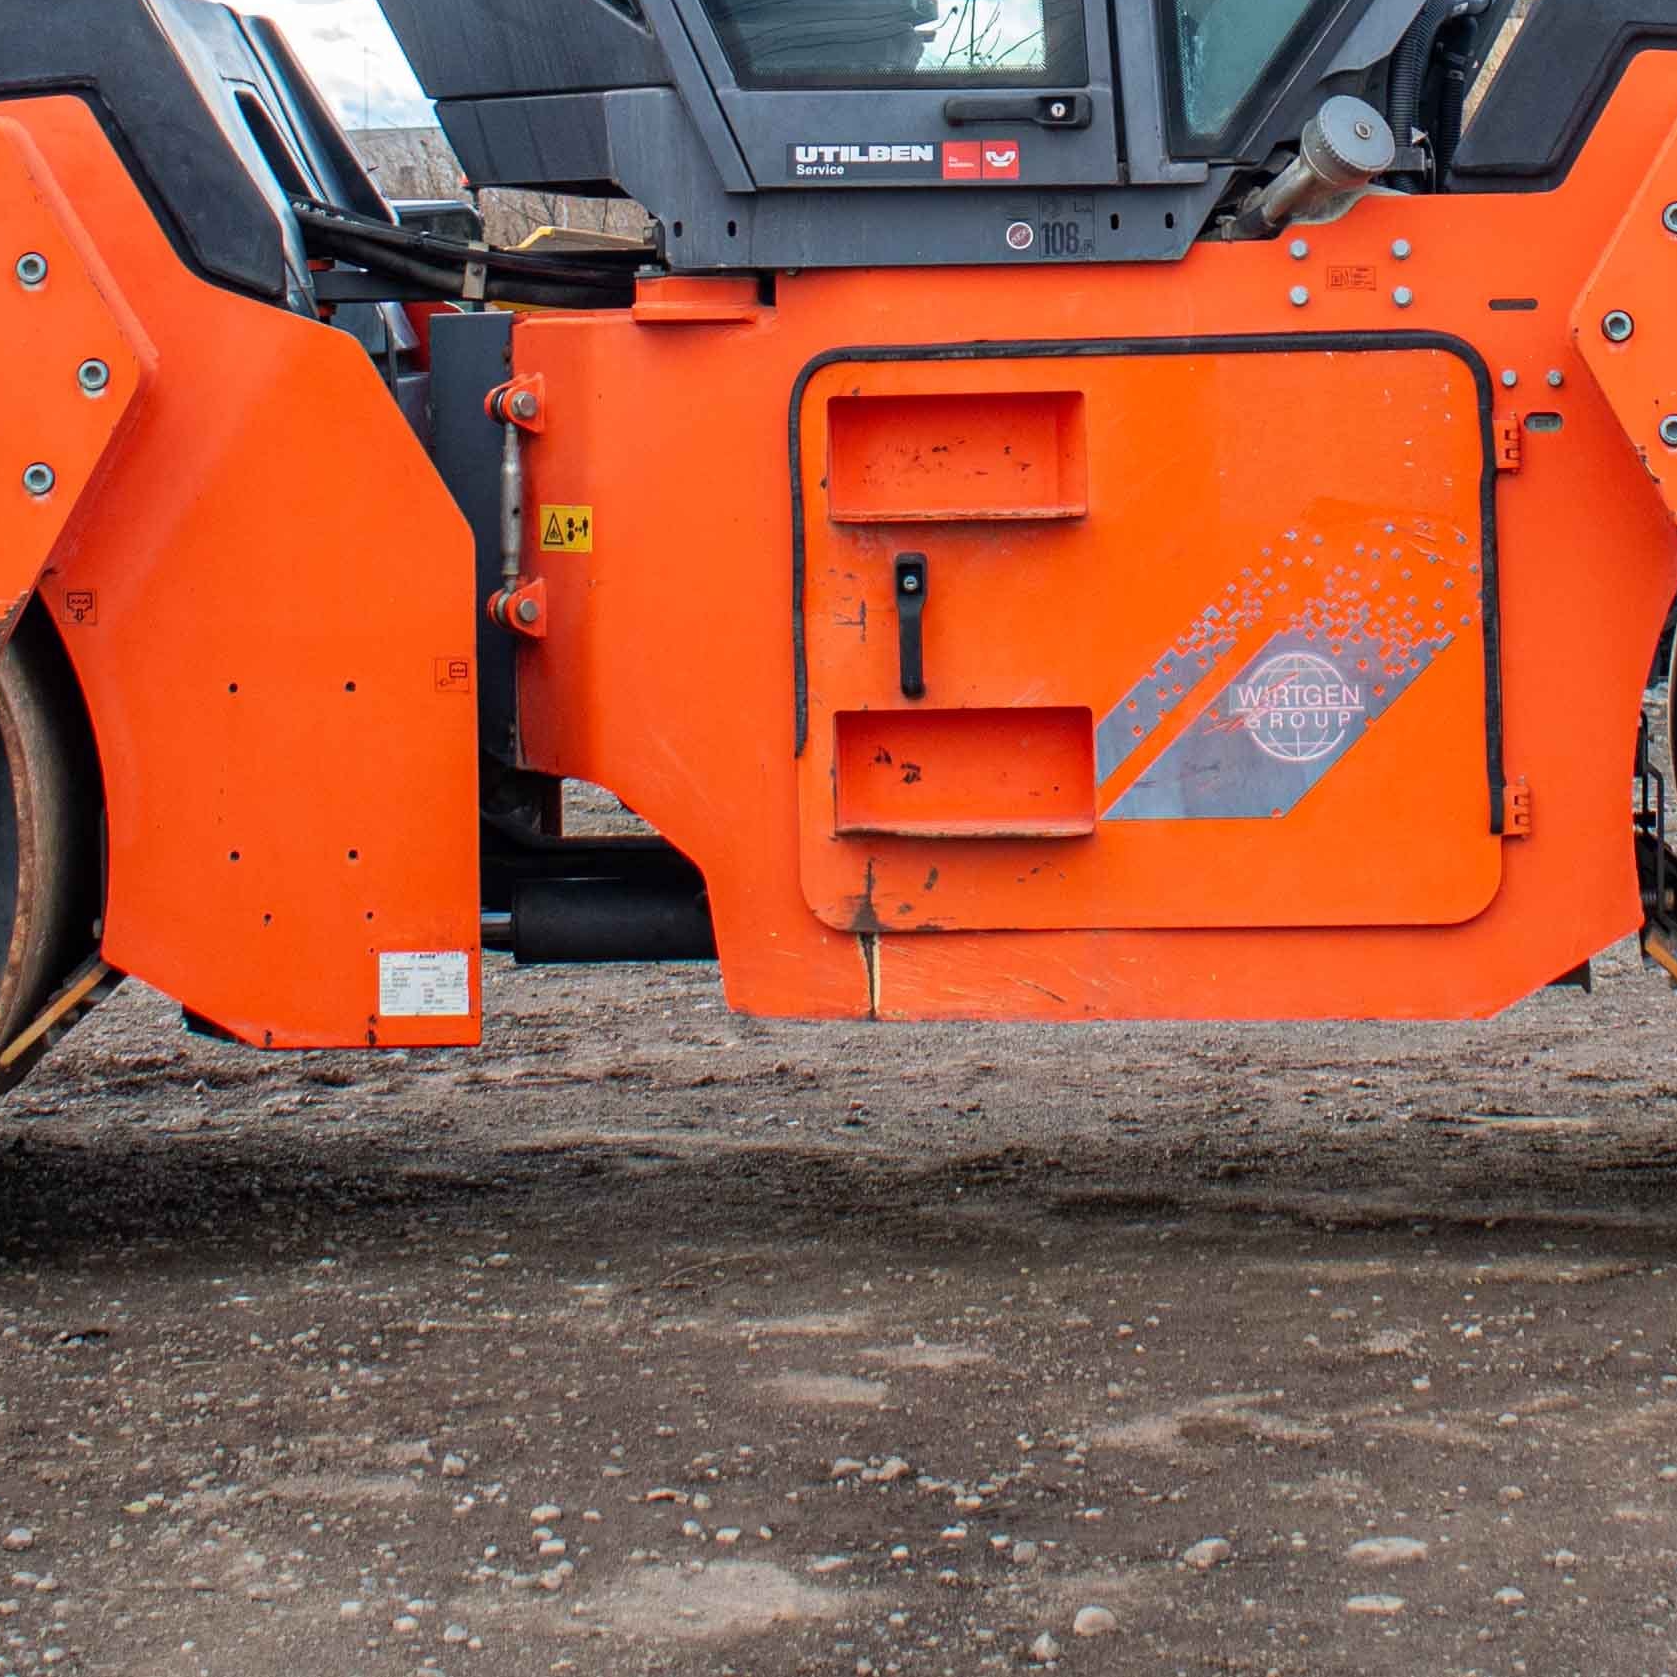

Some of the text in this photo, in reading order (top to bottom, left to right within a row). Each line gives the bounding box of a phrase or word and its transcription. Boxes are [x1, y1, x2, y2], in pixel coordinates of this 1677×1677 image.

[795, 145, 934, 163] UTILBEN
[796, 164, 845, 175] Service
[1042, 222, 1079, 255] 108
[1237, 683, 1361, 707] WIRTGEN
[1244, 711, 1352, 730] GROUP
